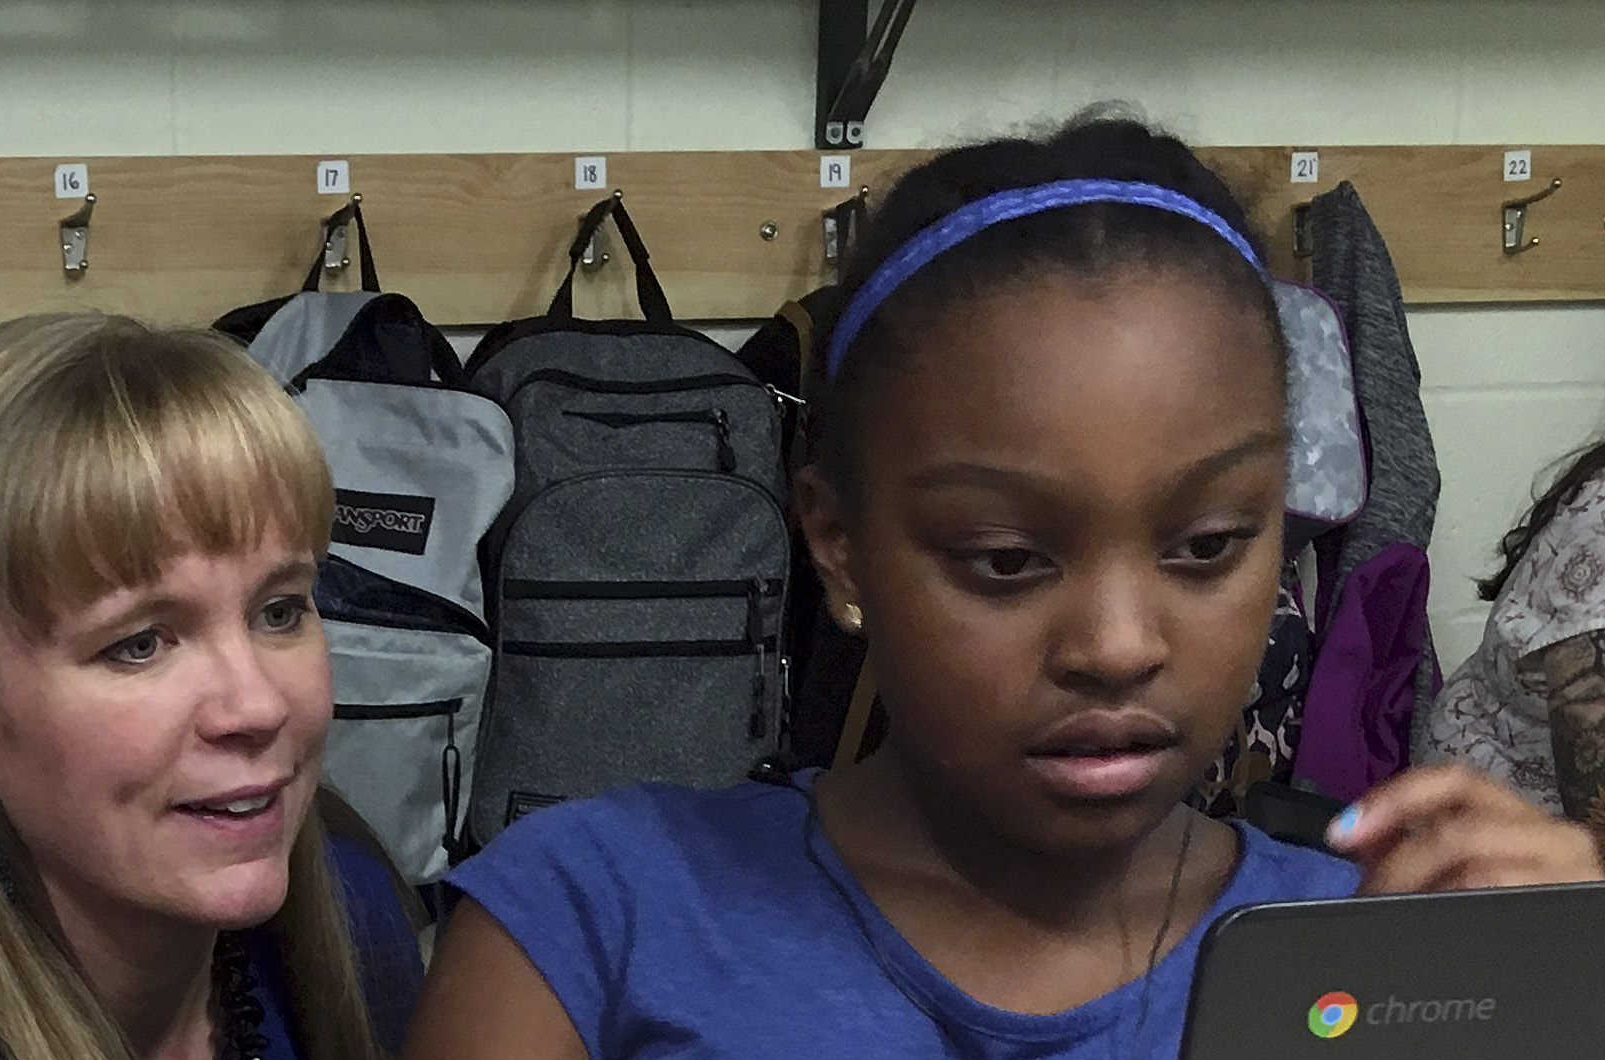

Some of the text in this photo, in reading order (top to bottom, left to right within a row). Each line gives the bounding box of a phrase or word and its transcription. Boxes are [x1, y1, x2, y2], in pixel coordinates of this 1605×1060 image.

[583, 165, 598, 183] 18
[828, 163, 842, 182] 19
[1297, 158, 1315, 177] 21
[1508, 160, 1528, 175] 22
[62, 172, 80, 191] 16
[325, 169, 339, 187] 17
[335, 504, 426, 534] ANSPORT
[1365, 995, 1496, 1025] chrome
